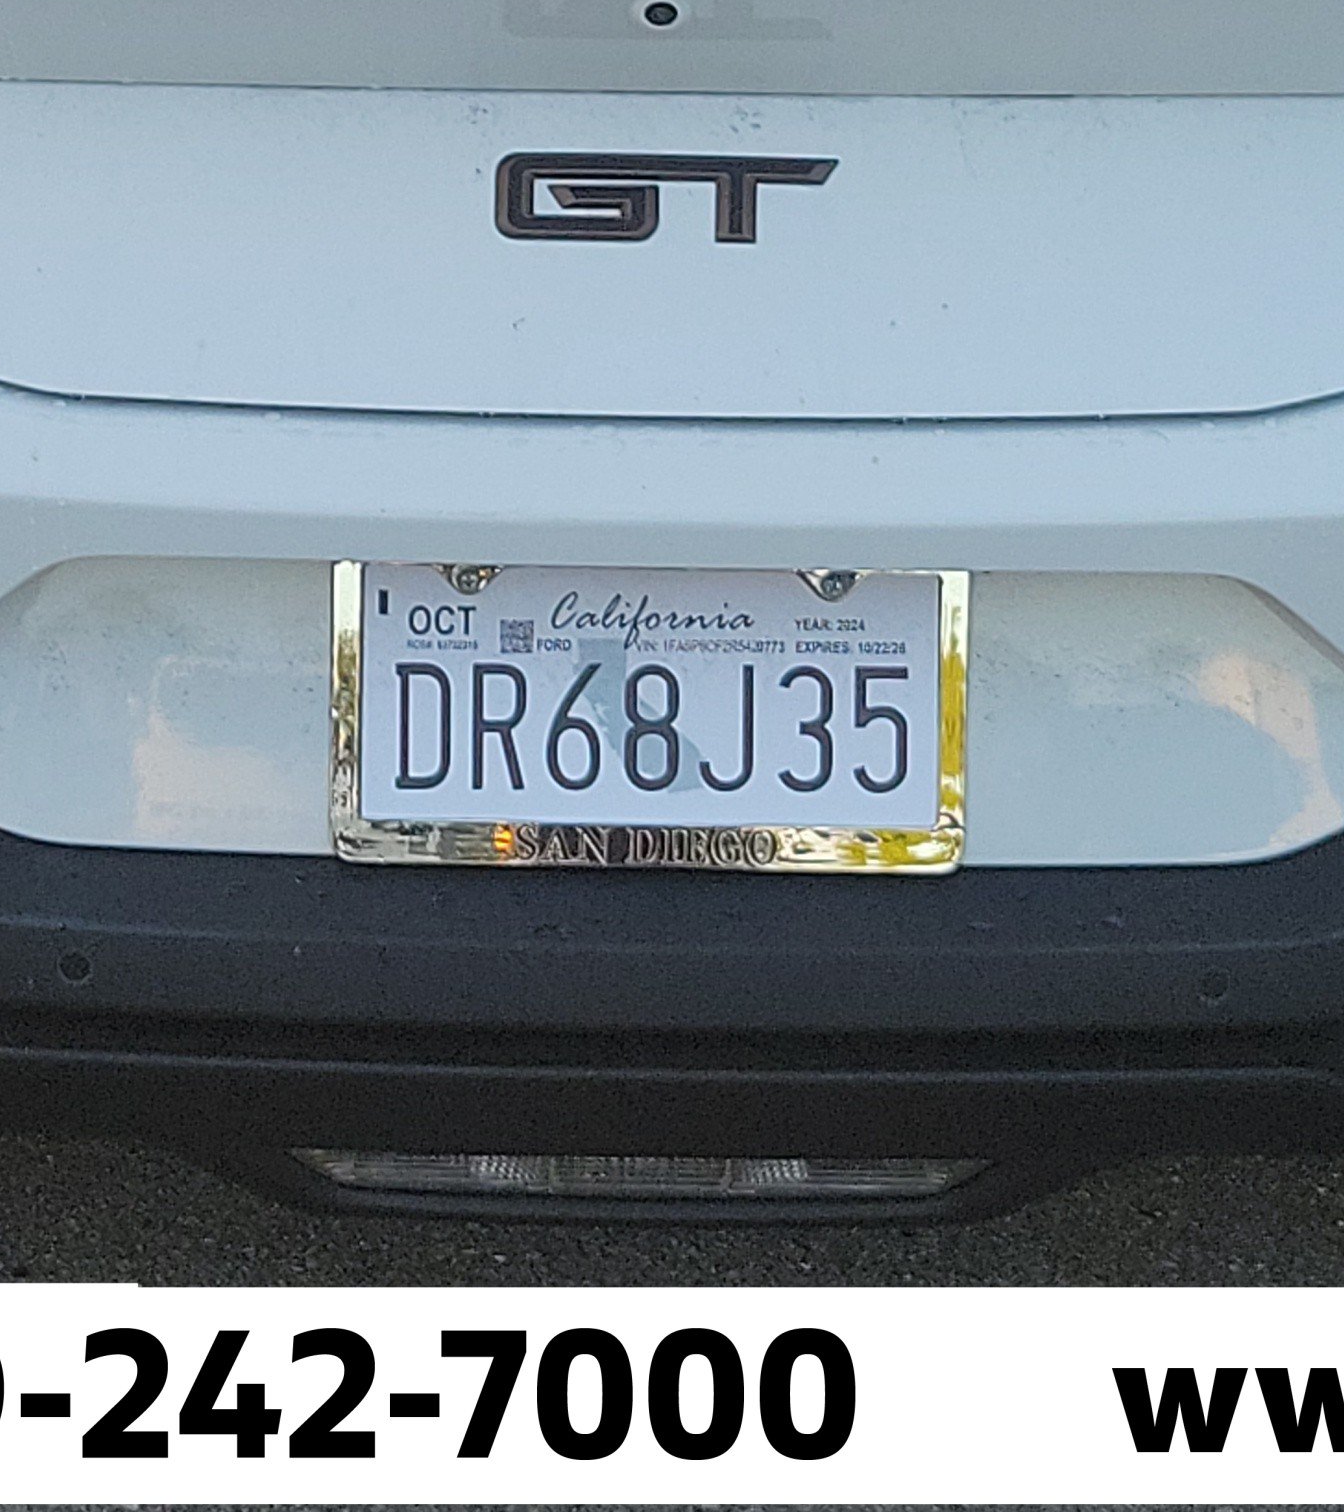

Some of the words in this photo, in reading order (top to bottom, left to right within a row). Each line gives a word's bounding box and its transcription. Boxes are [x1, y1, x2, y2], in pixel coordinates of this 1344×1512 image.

[495, 152, 840, 243] GT
[408, 604, 477, 636] OCT
[537, 638, 572, 652] FORD
[551, 591, 756, 650] California
[394, 662, 909, 794] DR68J35
[515, 823, 608, 864] SAN
[625, 825, 778, 867] DIEGO
